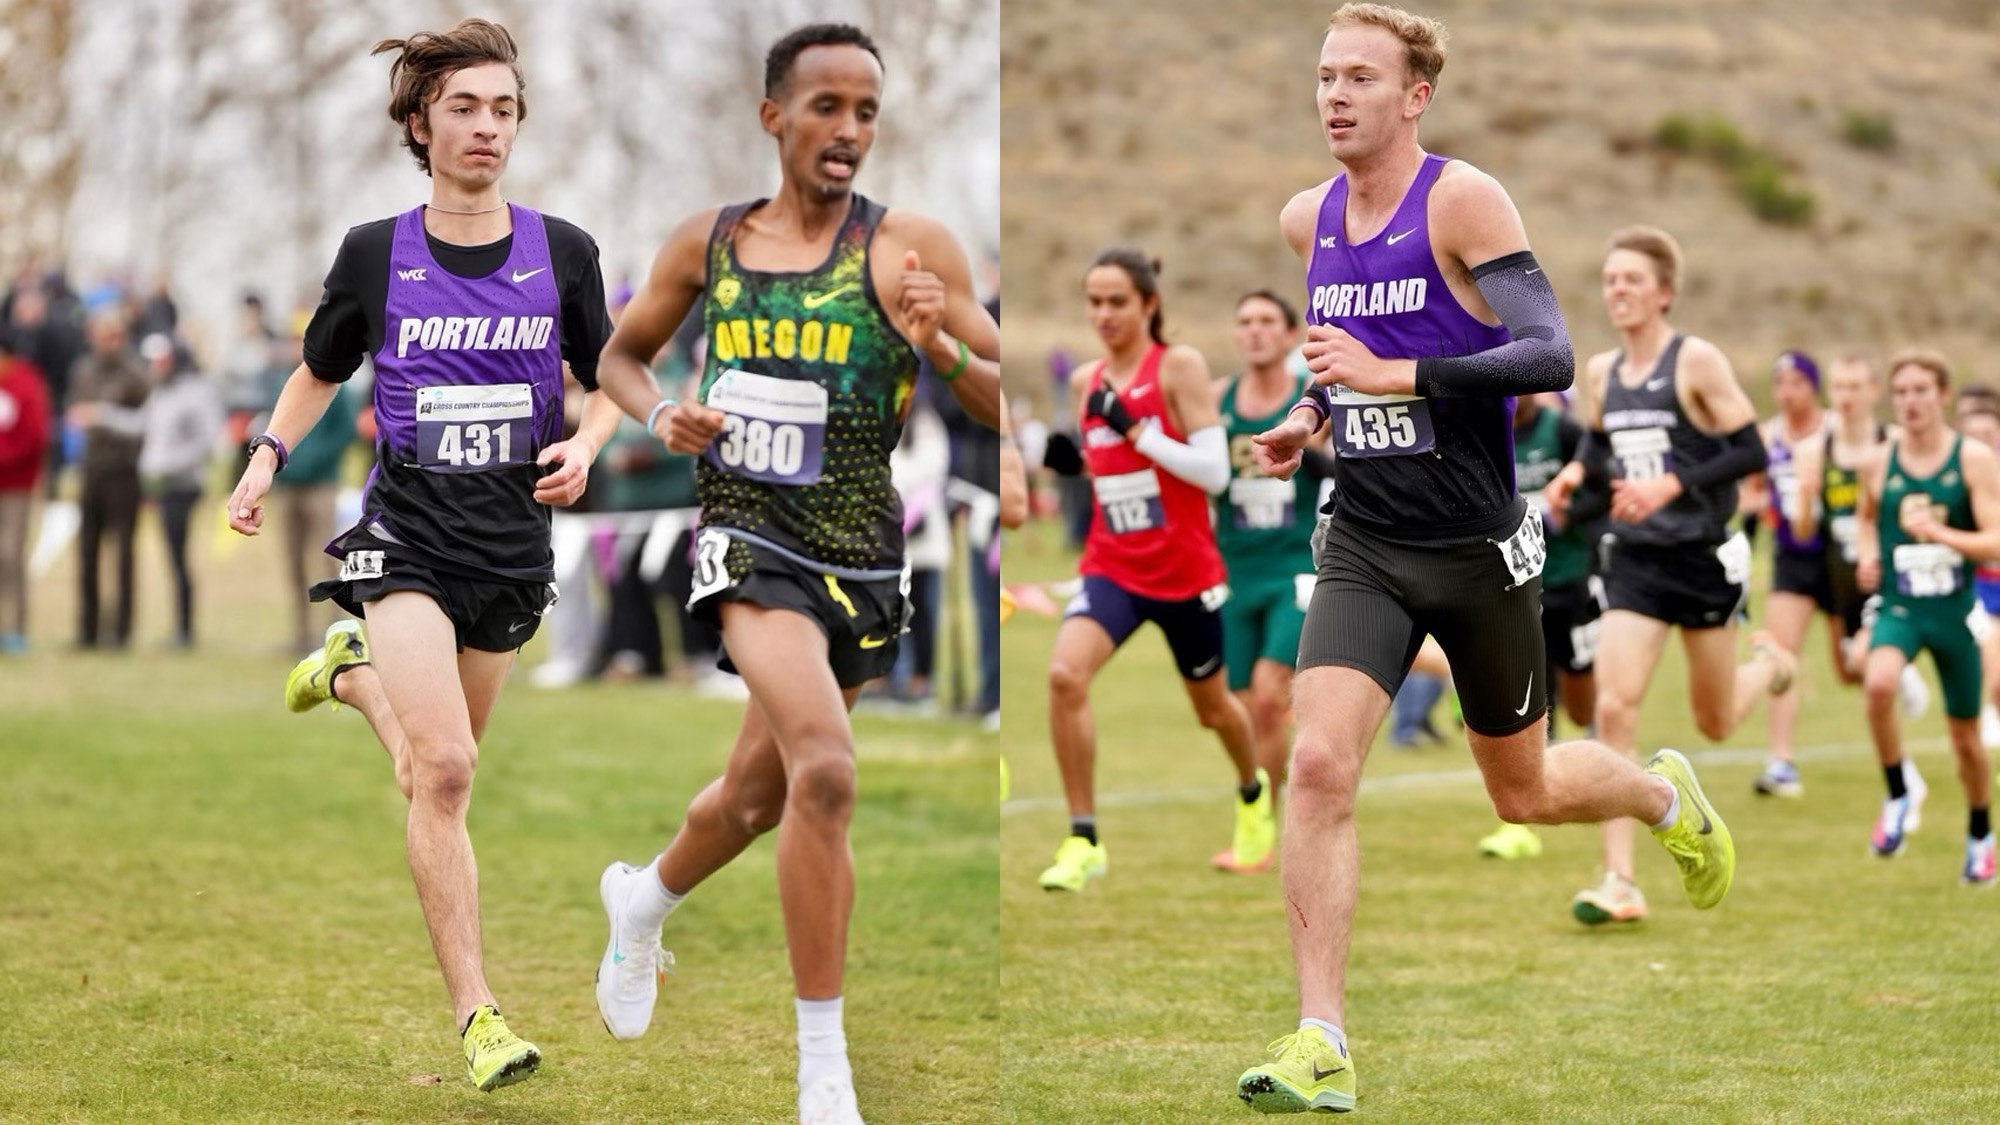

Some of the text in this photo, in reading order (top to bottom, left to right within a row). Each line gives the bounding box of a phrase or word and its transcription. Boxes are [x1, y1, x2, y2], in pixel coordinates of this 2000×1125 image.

[397, 268, 427, 281] WCC
[1312, 277, 1427, 325] PORTLAND
[397, 316, 554, 358] PORTLAND
[715, 318, 853, 365] OREGON
[433, 402, 453, 410] CROSS
[454, 401, 481, 410] COUNTRY
[1345, 405, 1417, 450] 435
[437, 422, 511, 467] 431
[720, 414, 805, 476] 380
